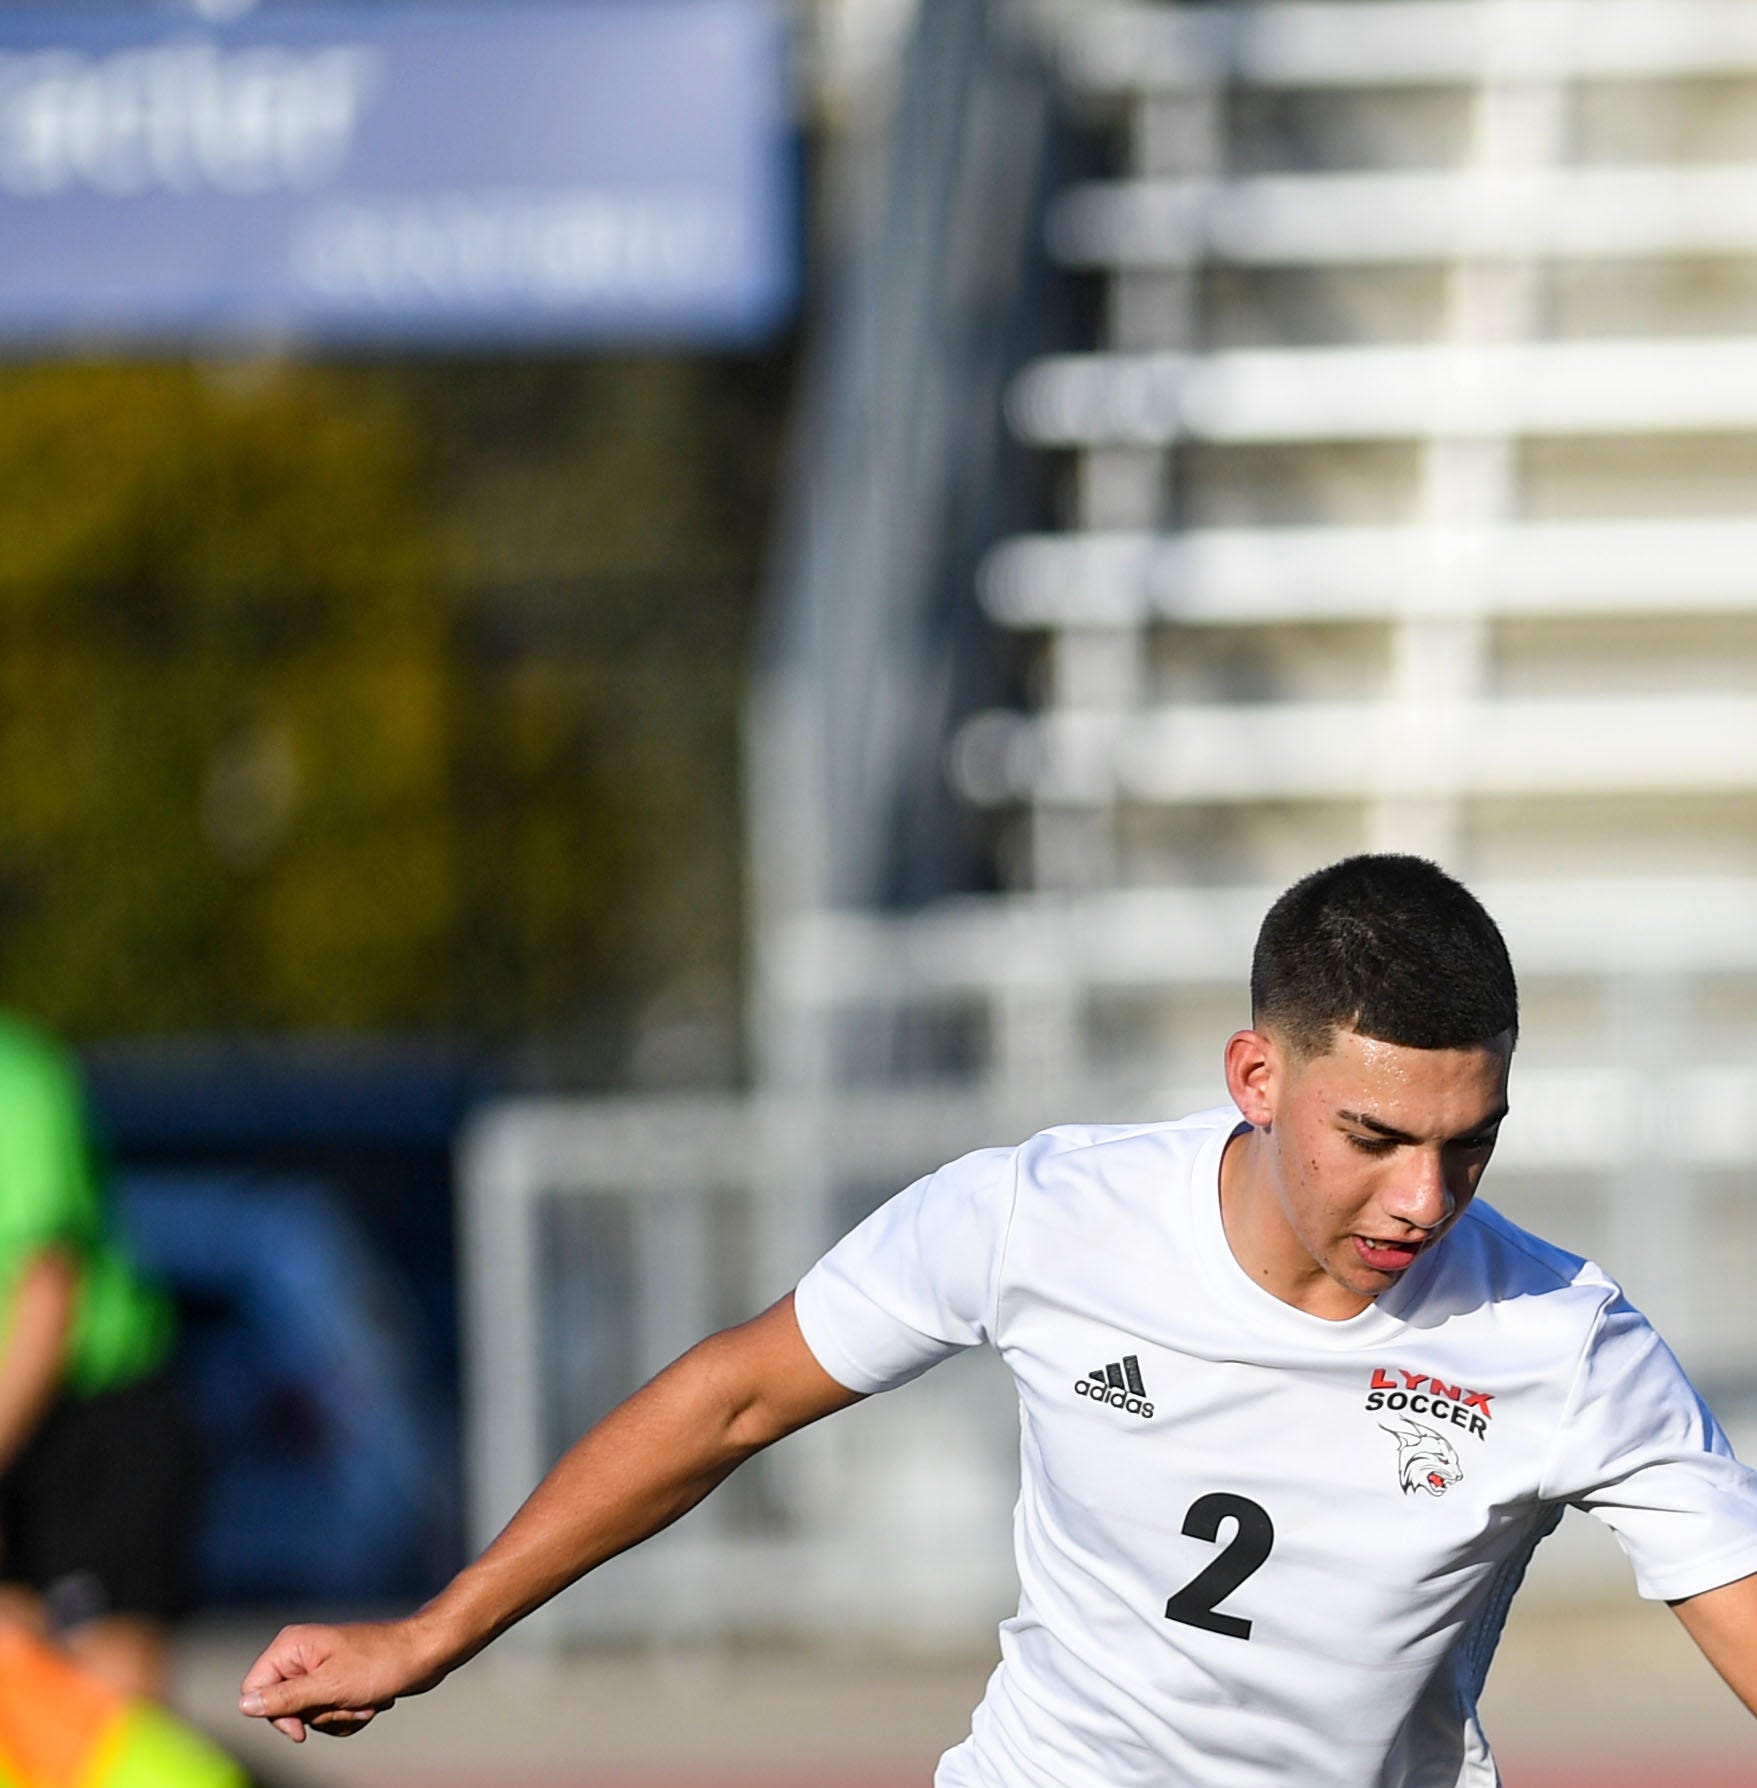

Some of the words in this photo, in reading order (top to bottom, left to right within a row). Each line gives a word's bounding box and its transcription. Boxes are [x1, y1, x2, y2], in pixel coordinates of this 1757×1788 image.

[1074, 1380, 1154, 1419] adidas
[1365, 1391, 1488, 1441] SOCCER
[1371, 1368, 1495, 1420] LYNX
[1165, 1492, 1274, 1640] 2
